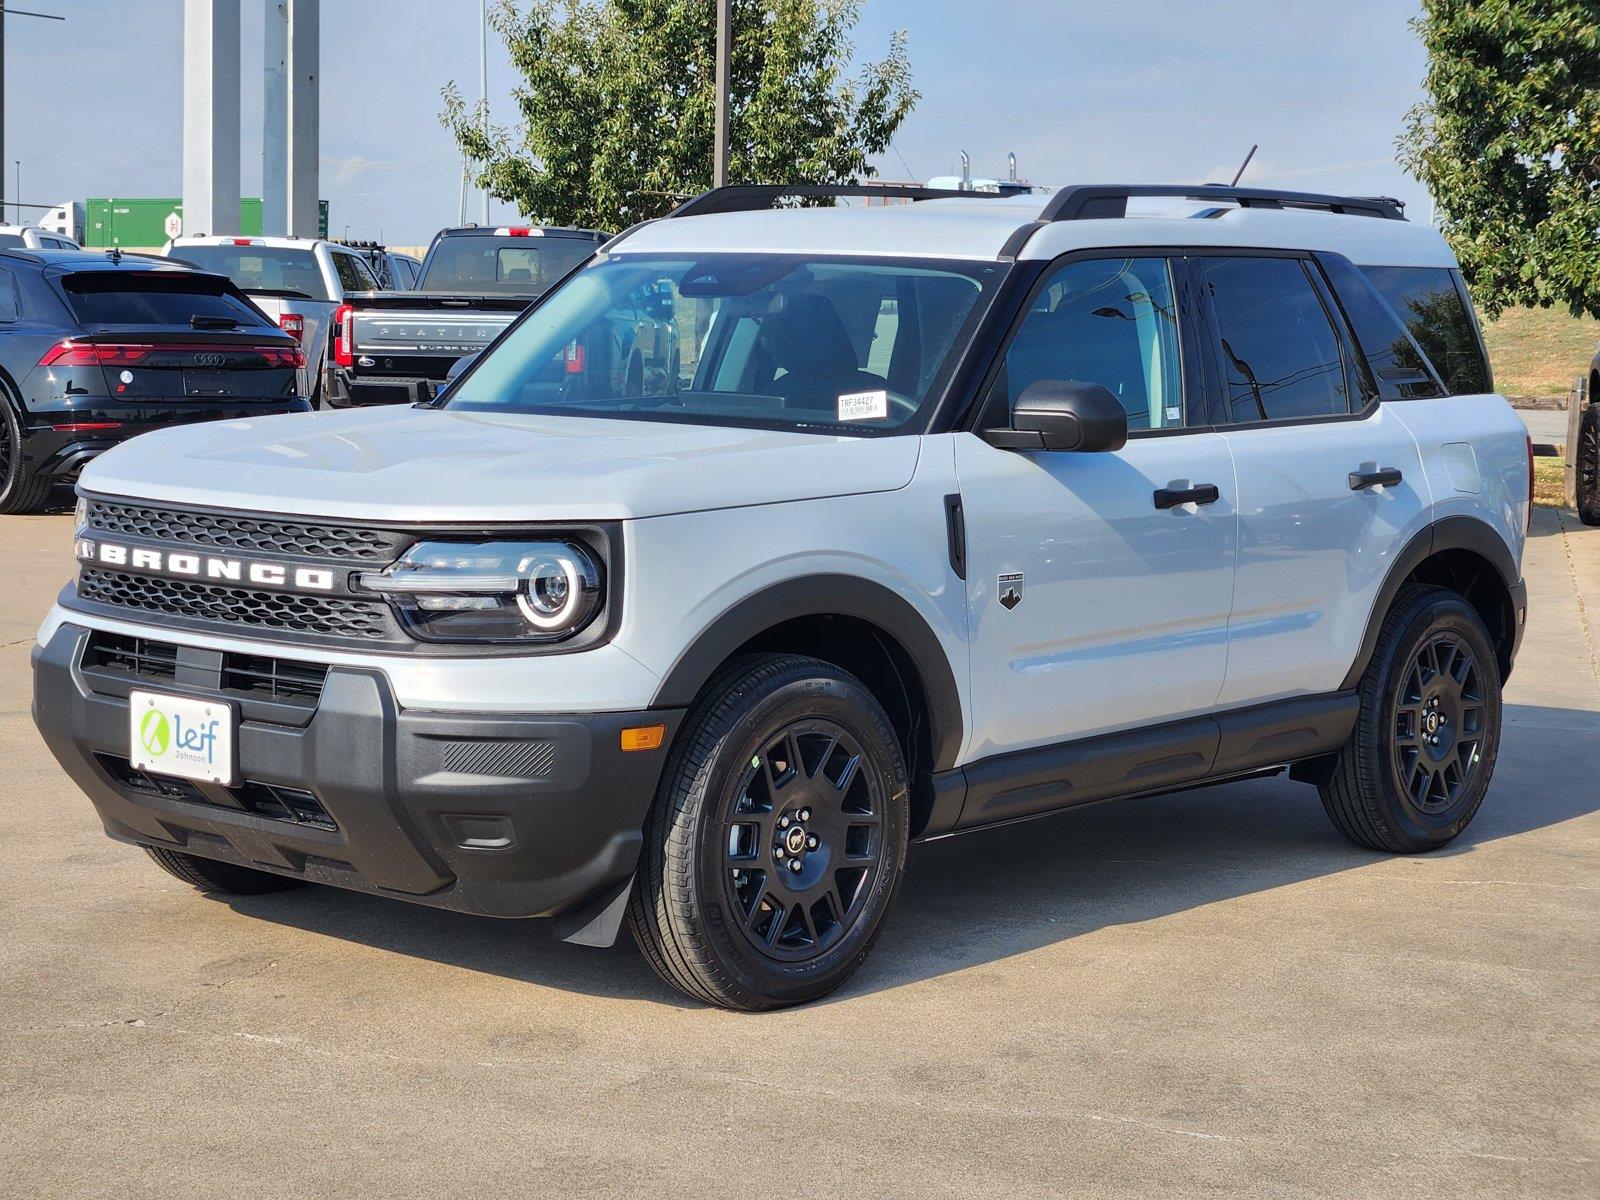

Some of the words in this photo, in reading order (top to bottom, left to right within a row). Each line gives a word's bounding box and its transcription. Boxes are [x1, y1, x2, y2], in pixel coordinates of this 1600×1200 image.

[841, 396, 873, 407] TRF34427
[100, 544, 333, 589] BRONCO
[175, 750, 206, 763] Johnson
